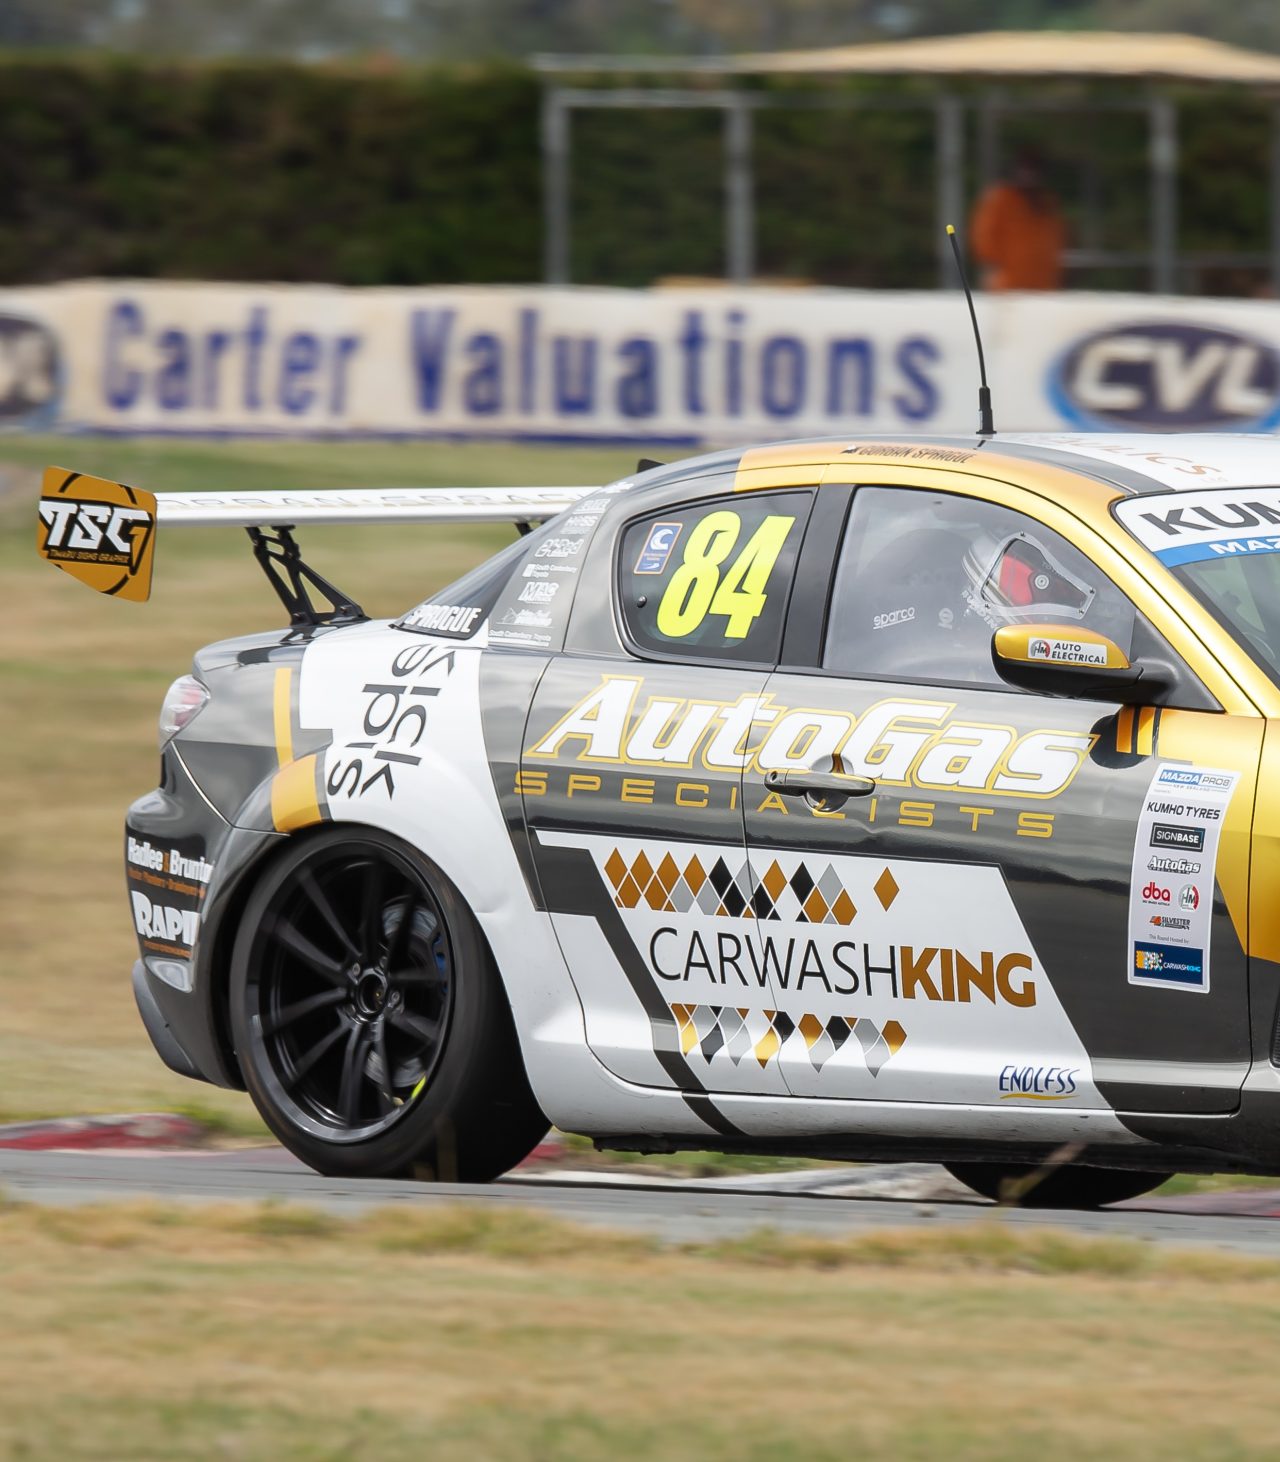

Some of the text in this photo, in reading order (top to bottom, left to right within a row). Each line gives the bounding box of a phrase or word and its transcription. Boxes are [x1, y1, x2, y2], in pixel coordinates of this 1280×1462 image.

[104, 298, 361, 415] Carter
[408, 308, 942, 420] Valuations
[1070, 335, 1272, 413] CVL
[656, 511, 796, 639] 84
[403, 604, 482, 633] SPRAGUE
[873, 606, 916, 629] sparco
[1051, 651, 1106, 665] ELECTRICAL
[1054, 642, 1082, 652] AUTO
[524, 674, 1099, 799] AutoGas
[1160, 770, 1199, 784] MAZDA
[513, 770, 1055, 839] SPECIALISTS
[1147, 801, 1221, 820] KUMHO TYRES
[1156, 830, 1199, 843] SIGNBASE
[1148, 855, 1201, 874] AutoGas
[1142, 882, 1170, 902] dba
[650, 926, 1037, 1008] CARWASHKING
